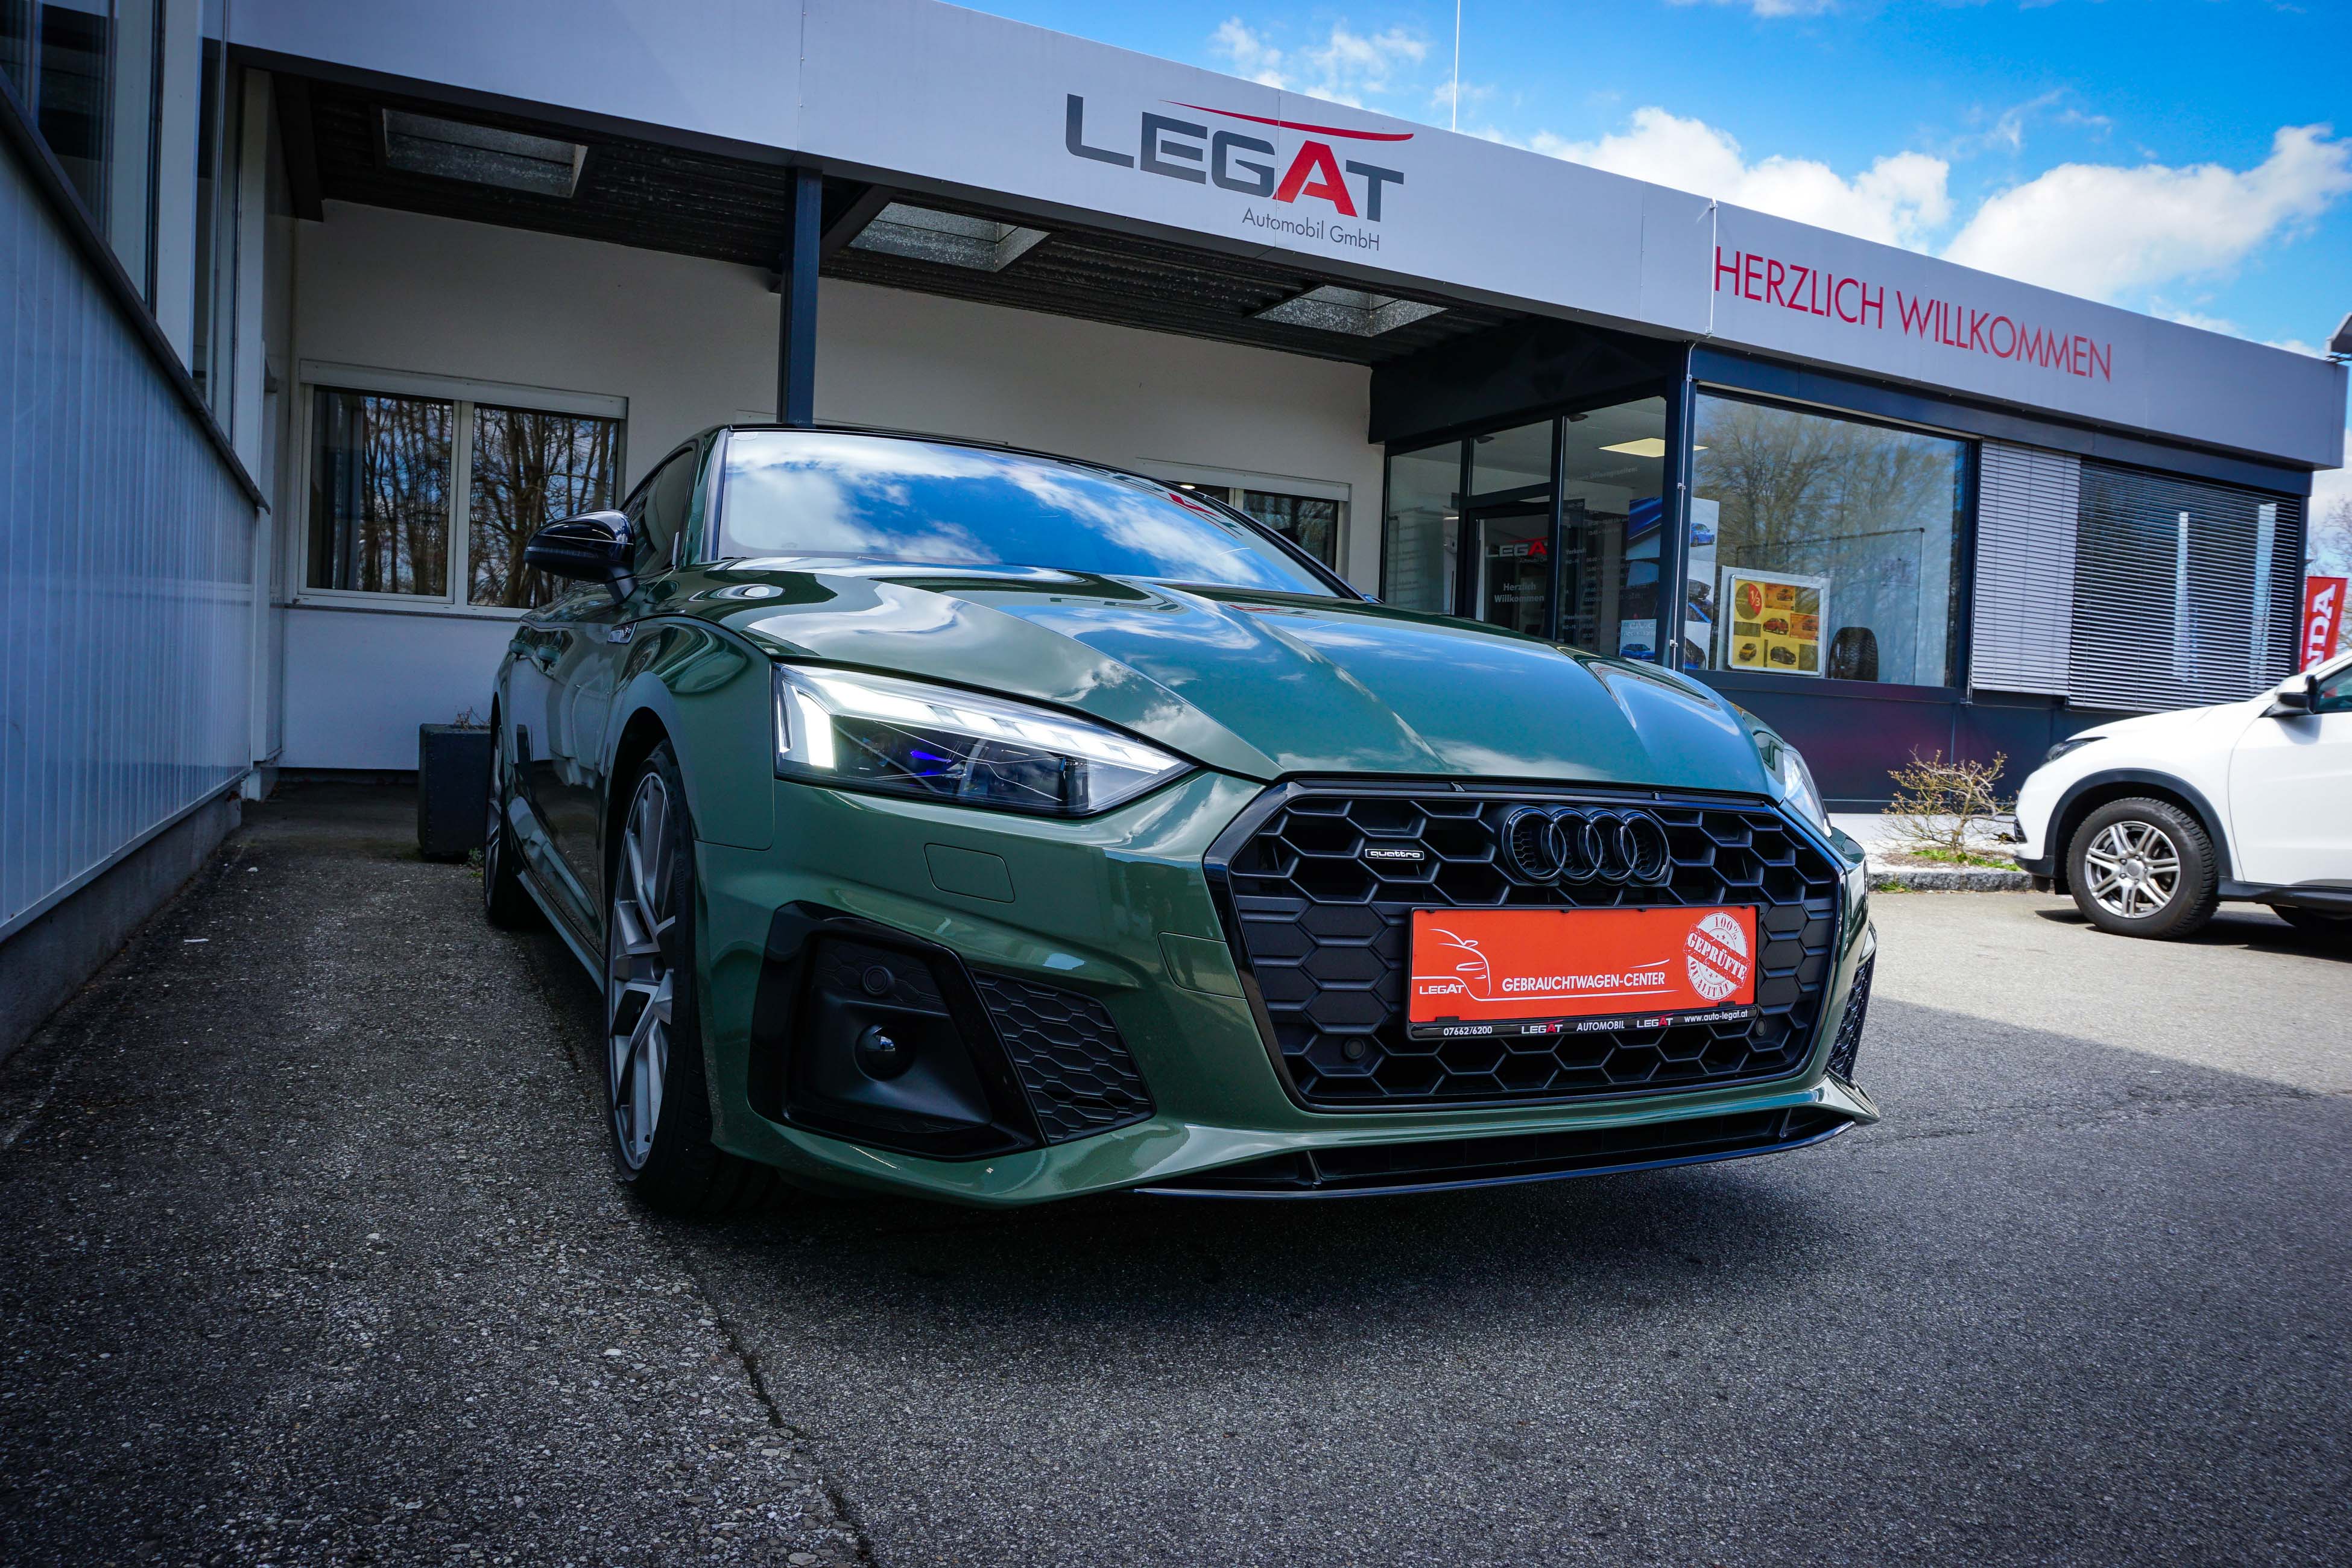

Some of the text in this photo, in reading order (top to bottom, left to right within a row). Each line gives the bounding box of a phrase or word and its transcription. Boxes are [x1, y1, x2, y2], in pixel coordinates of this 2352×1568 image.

[1066, 93, 1404, 222] LEGAT
[1242, 207, 1380, 251] Automobil GmbH
[1715, 246, 2111, 383] HERZLICH WILLKOMMEN
[1485, 541, 1548, 557] LEGA
[1494, 594, 1544, 603] Willkommen
[1503, 582, 1536, 592] Herzlich
[1715, 916, 1739, 940] 100%
[1688, 932, 1748, 981] GEPRÜFTE
[1419, 984, 1465, 994] LEGAT
[1502, 972, 1665, 992] GEBRAUCHTWAGEN-CENTER
[1690, 961, 1729, 997] QUALITÄT
[1443, 1009, 1748, 1036] 07662/6200 LEGAT AUTOMOBIL LEGAT www.auto-legat.at
